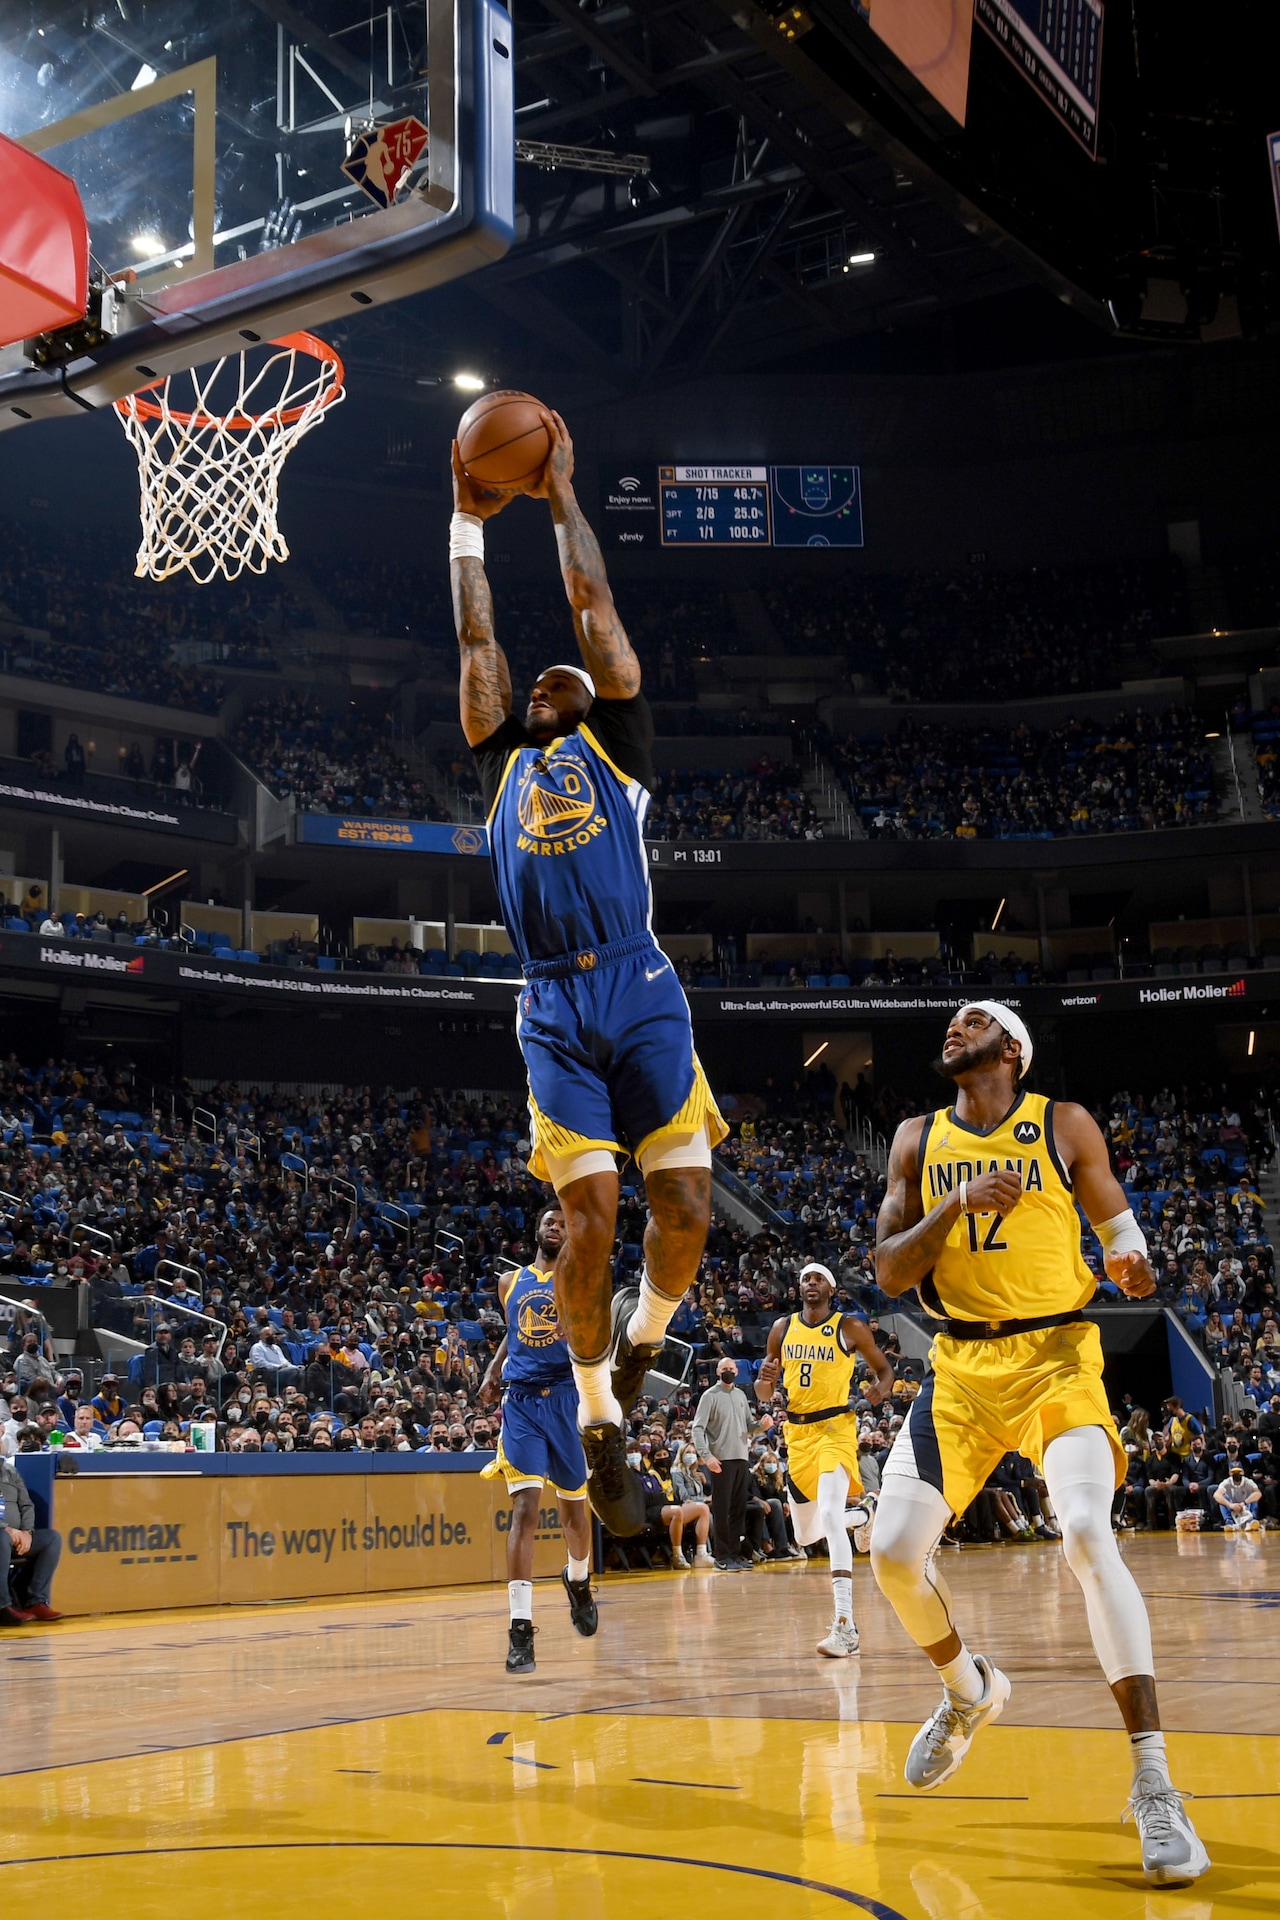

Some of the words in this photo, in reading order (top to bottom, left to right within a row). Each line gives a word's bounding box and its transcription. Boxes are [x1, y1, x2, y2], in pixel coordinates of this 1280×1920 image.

[394, 130, 411, 159] 75
[685, 469, 708, 480] SHOT
[711, 468, 753, 480] TRACKER
[608, 494, 631, 505] Enjoy
[665, 490, 678, 499] FG
[695, 487, 719, 501] 7/15
[665, 509, 682, 519] 3PT
[696, 506, 715, 520] 2/8
[619, 533, 644, 543] xfinity
[666, 528, 678, 538] FT
[698, 525, 715, 541] 1/1
[493, 553, 511, 563] 210
[564, 773, 581, 795] 0
[343, 820, 410, 833] WARRIORS
[516, 814, 608, 856] WARRIORS
[673, 851, 687, 861] P1
[693, 849, 722, 863] 13:01
[40, 946, 84, 967] Holier
[84, 952, 128, 972] Molier
[179, 966, 223, 983] Ultra-fast,
[223, 972, 284, 990] ultra-powerful
[284, 980, 298, 991] 5G
[299, 980, 322, 993] Ultra
[321, 983, 370, 995] Wideband
[370, 985, 379, 995] is
[379, 985, 401, 996] here
[401, 987, 411, 997] in
[411, 987, 441, 999] Chase
[440, 989, 476, 1001] Center.
[1061, 996, 1097, 1007] verizon
[1139, 988, 1182, 1003] Holier
[1183, 984, 1229, 999] Molier
[720, 1001, 767, 1012] Ultra-fast,
[766, 1000, 832, 1012] ultra-powerful
[832, 1000, 847, 1009] 5G
[847, 999, 870, 1009] Ultra
[870, 998, 918, 1009] Wideband
[918, 998, 926, 1008] is
[926, 998, 948, 1008] here
[948, 998, 958, 1008] in
[965, 1211, 1008, 1253] 12
[540, 1304, 557, 1318] 22
[517, 1330, 563, 1348] WARRIOR
[784, 1344, 834, 1362] INDIANA
[799, 1362, 812, 1388] 8
[226, 1520, 276, 1558] The
[282, 1527, 336, 1563] way
[341, 1517, 357, 1551] it
[362, 1513, 434, 1551] should
[440, 1513, 472, 1545] be.
